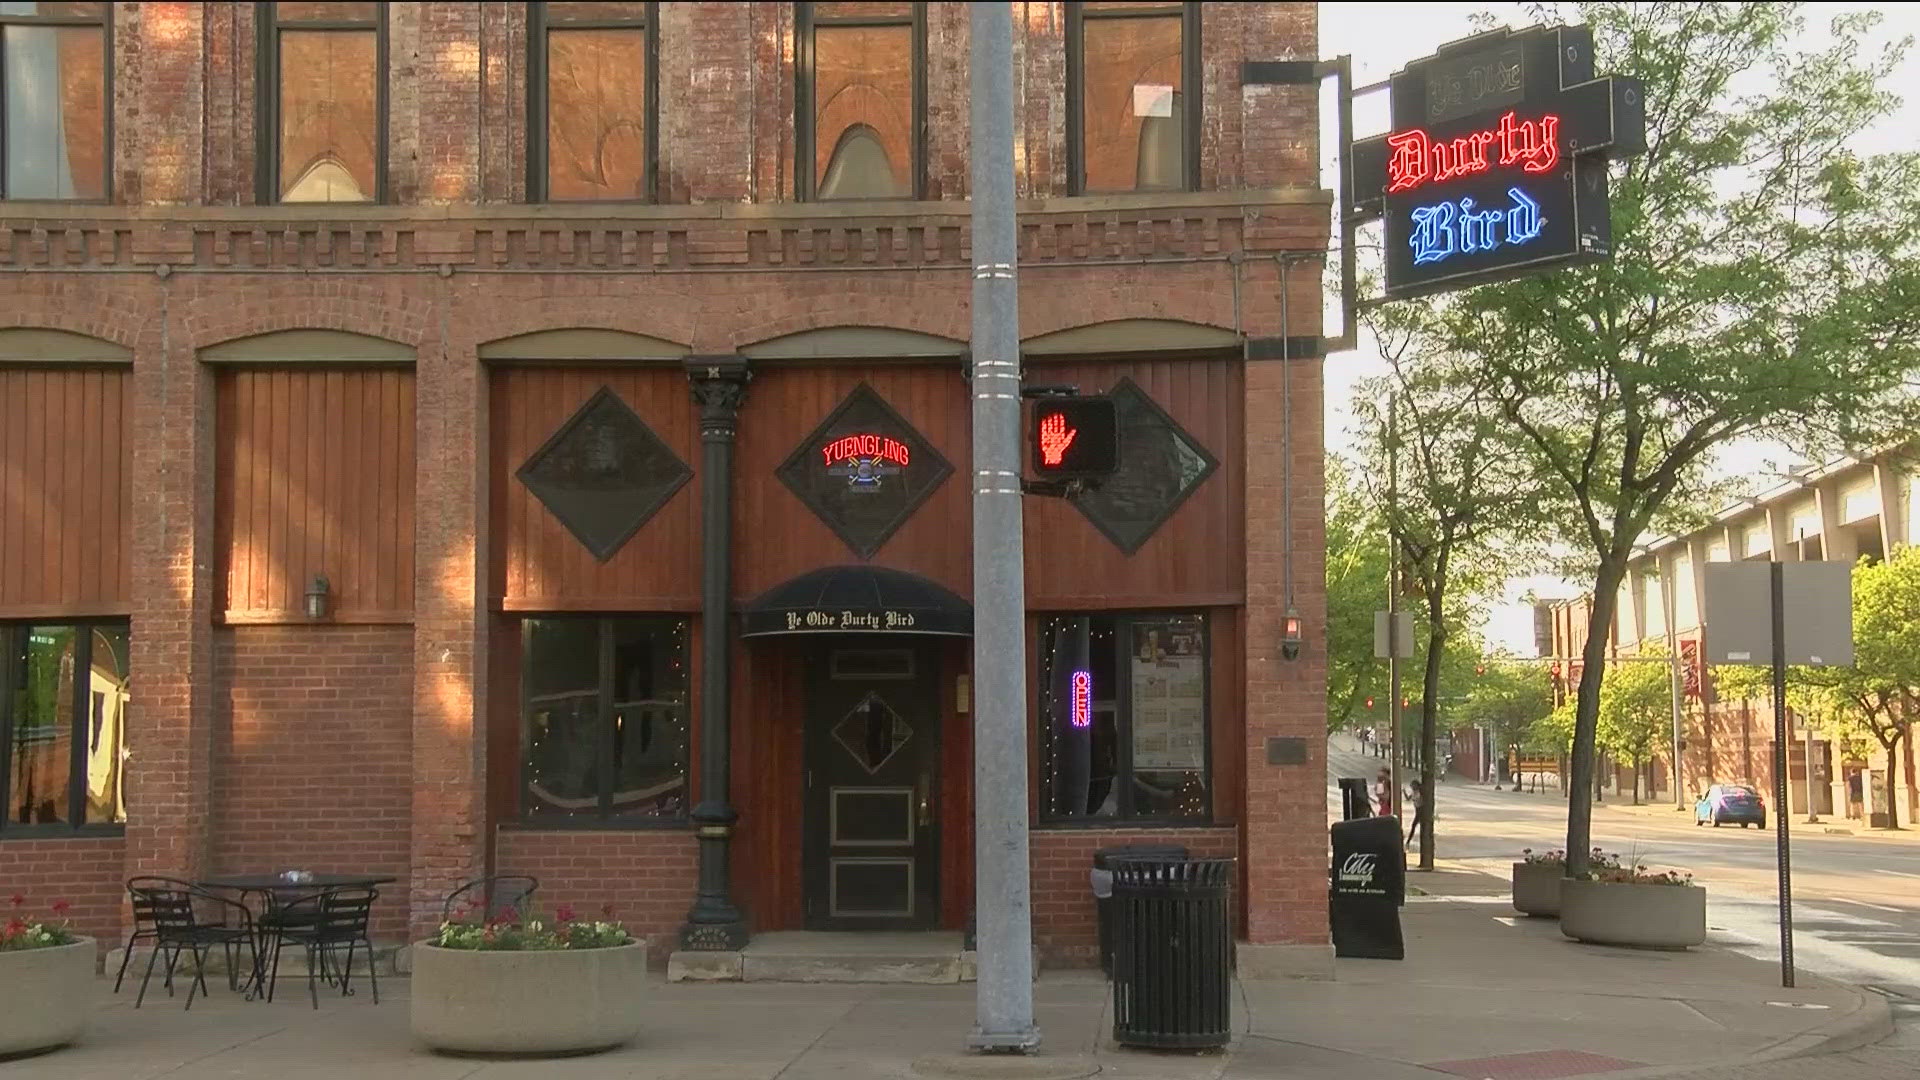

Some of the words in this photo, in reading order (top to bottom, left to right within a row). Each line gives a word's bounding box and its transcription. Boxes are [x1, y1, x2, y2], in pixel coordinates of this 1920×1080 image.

[1387, 111, 1559, 193] Durty
[1409, 187, 1548, 266] Bird
[822, 434, 909, 466] YUENGLING
[786, 611, 801, 630] Ye
[806, 610, 835, 627] Olde
[840, 610, 880, 630] Durty
[885, 610, 915, 630] Bird
[1075, 674, 1088, 727] OPEN
